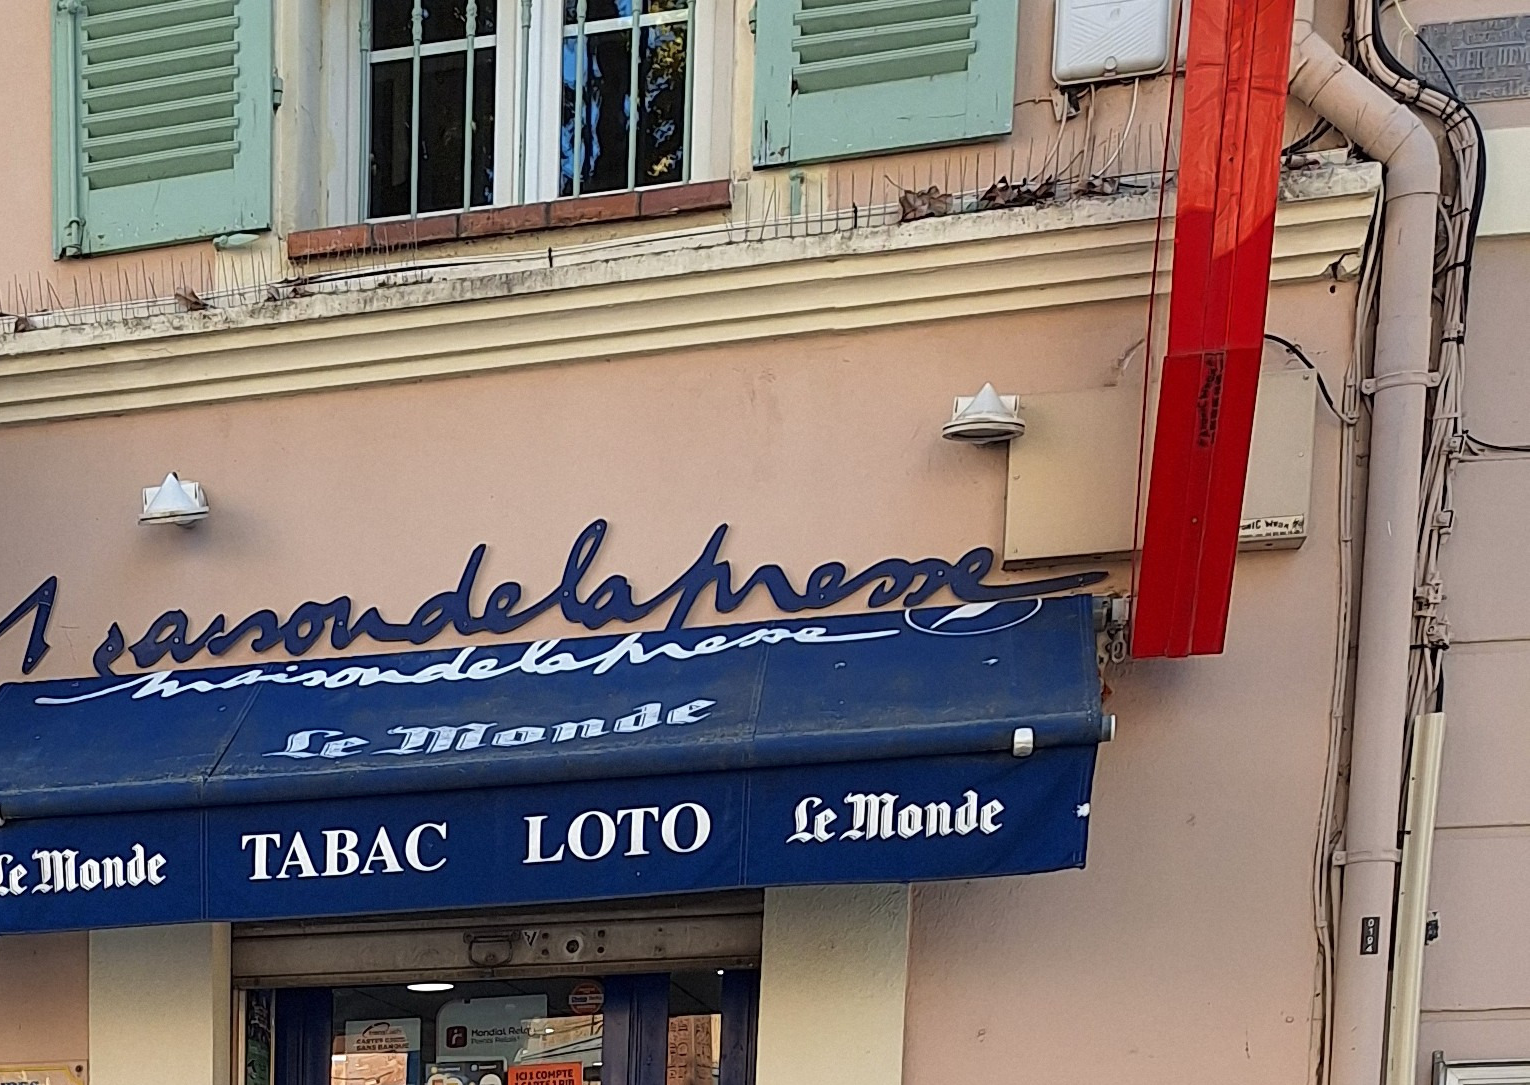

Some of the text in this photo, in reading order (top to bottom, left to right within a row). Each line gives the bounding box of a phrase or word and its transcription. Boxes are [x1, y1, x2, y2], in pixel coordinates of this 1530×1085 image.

[371, 697, 717, 756] Monde
[241, 802, 711, 881] TABAC LOTO
[787, 790, 1004, 844] Le Monde
[32, 844, 168, 893] Monde
[471, 1027, 507, 1038] Mondial
[515, 1069, 574, 1081] ICI 1 COMPTE
